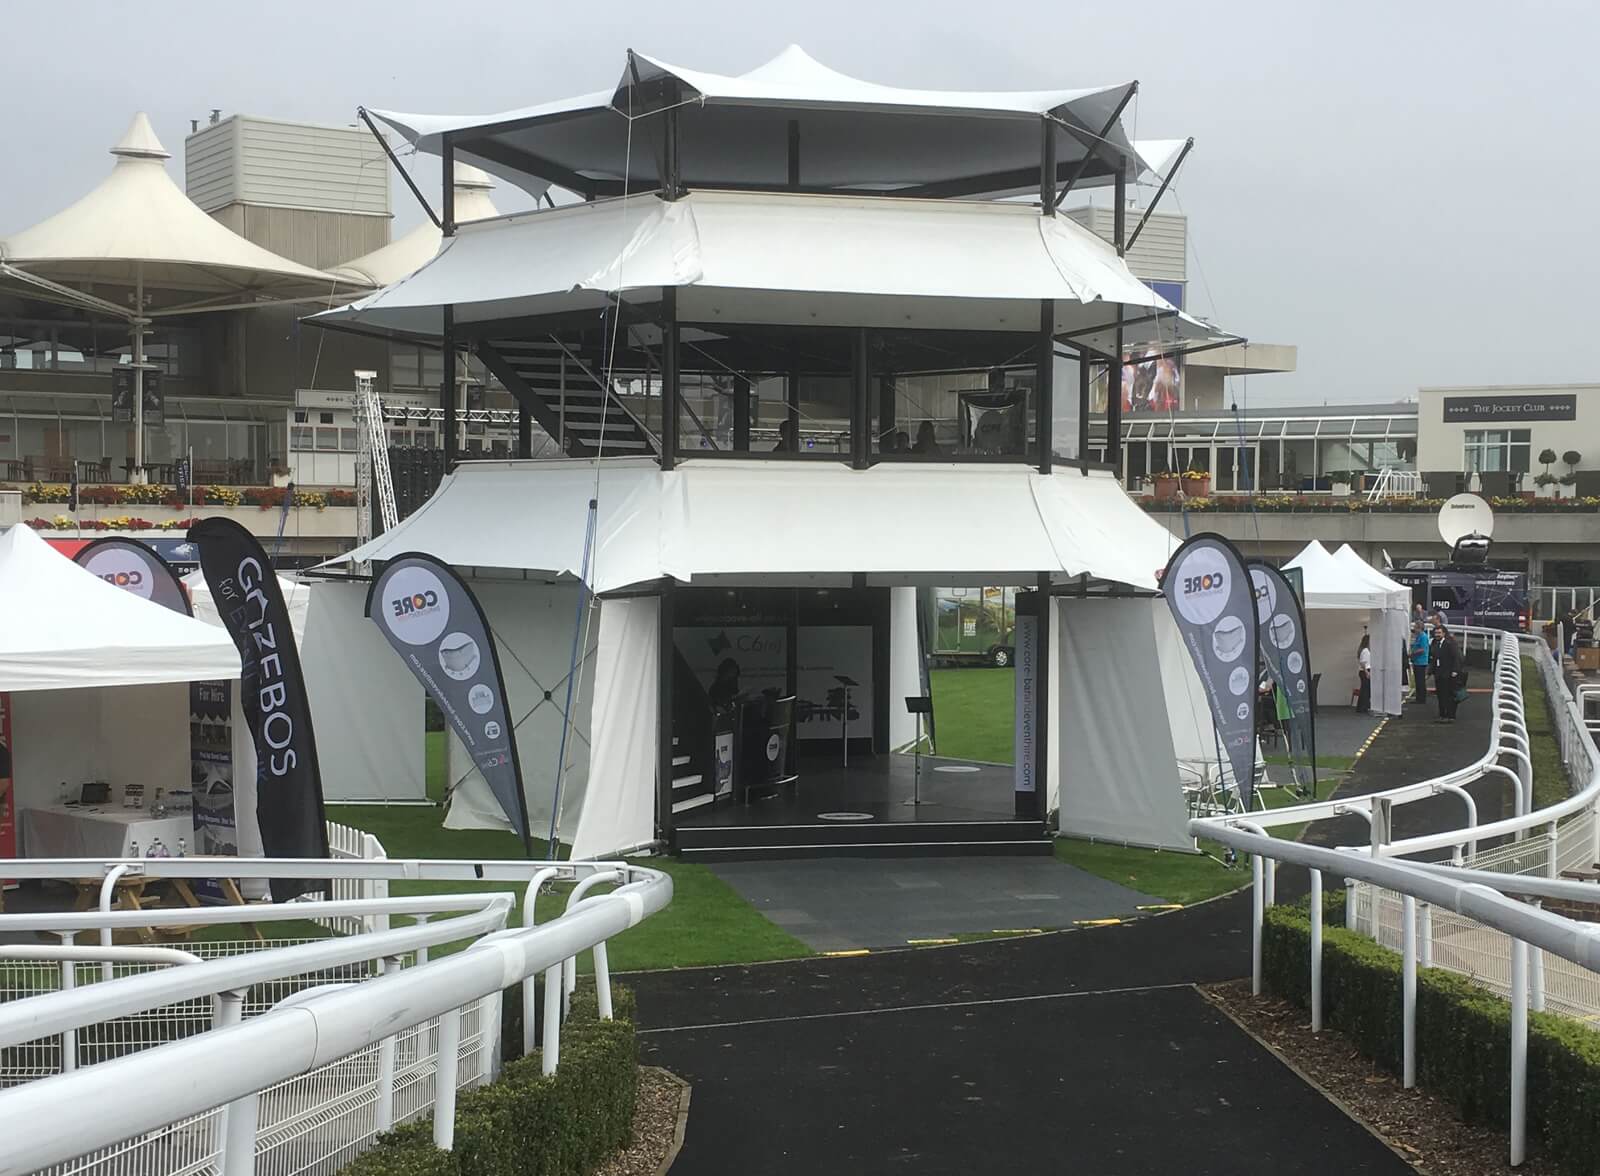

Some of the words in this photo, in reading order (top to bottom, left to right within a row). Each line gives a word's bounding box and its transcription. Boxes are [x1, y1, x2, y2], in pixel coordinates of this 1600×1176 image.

[1473, 404, 1489, 413] THE
[1491, 404, 1521, 414] JOCKEY
[1523, 403, 1545, 412] CLUB
[218, 577, 240, 600] for
[236, 556, 297, 778] GAZEBOS
[199, 687, 210, 702] For
[210, 687, 225, 703] Hire
